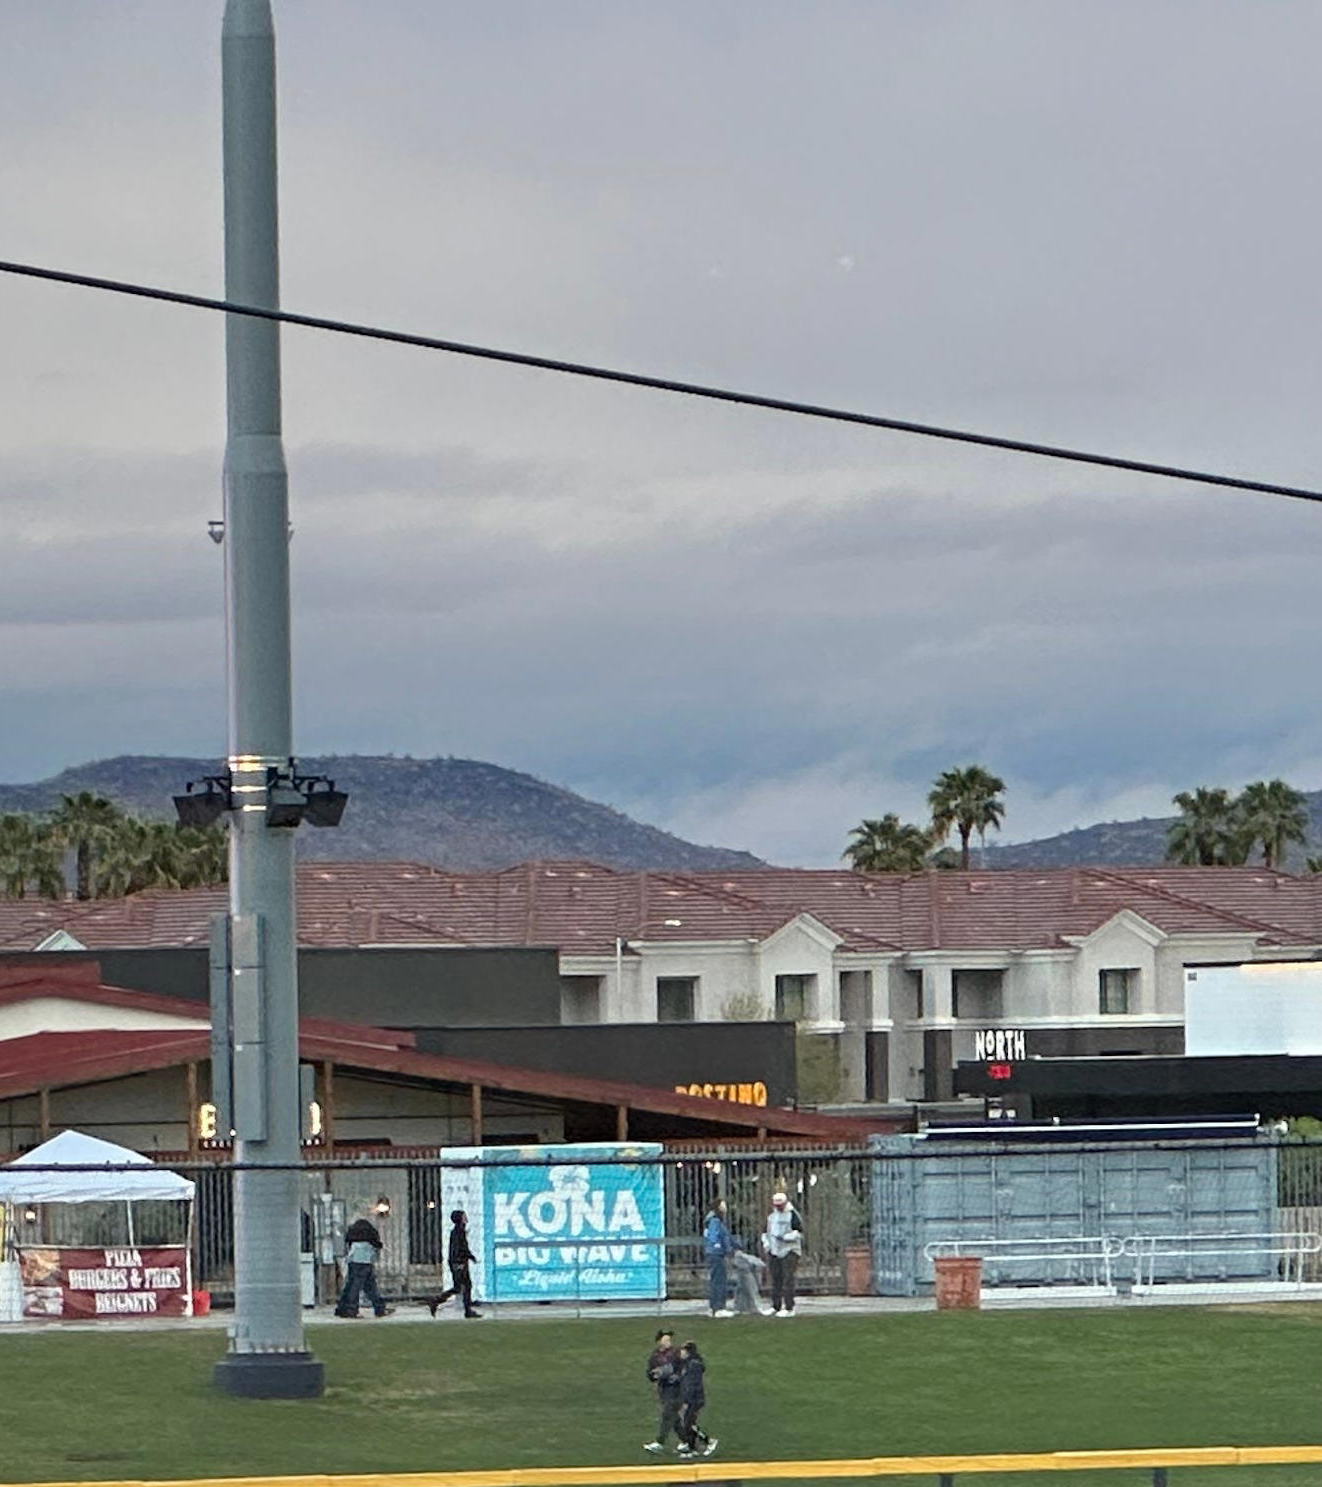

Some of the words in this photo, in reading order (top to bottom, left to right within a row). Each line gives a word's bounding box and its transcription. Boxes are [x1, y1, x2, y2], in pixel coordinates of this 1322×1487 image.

[975, 1029, 1026, 1061] NORTH
[494, 1190, 646, 1238] KONA
[130, 1268, 142, 1288] &
